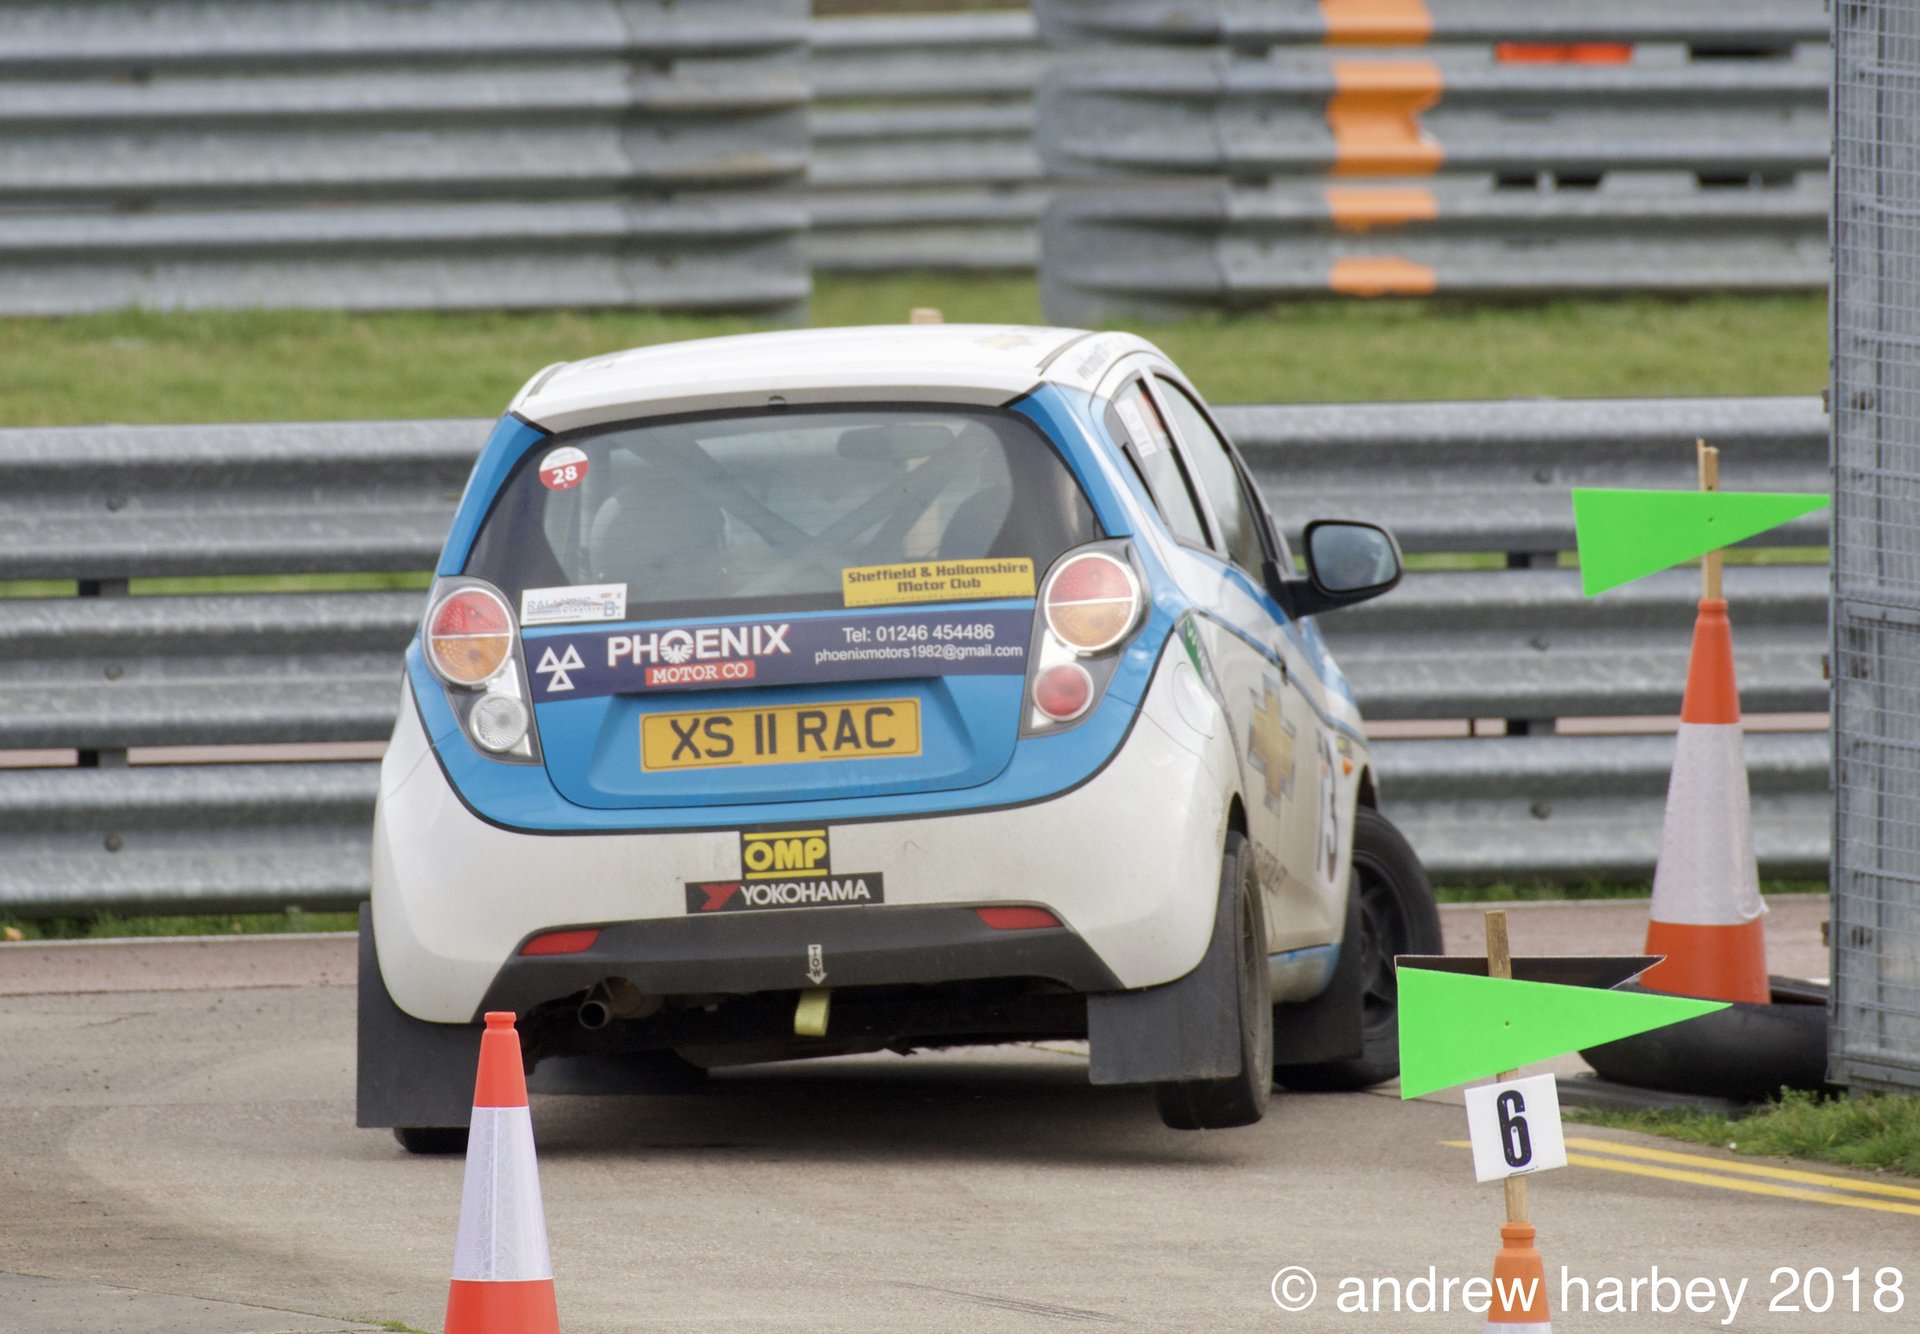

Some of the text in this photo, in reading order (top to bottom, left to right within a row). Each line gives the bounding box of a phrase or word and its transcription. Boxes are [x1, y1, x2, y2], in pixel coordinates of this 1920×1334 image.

[551, 465, 578, 485] 28
[847, 563, 1028, 584] Sheffield & Hallamshire
[897, 577, 981, 593] Motor Club
[842, 624, 995, 643] Tel: 01246 454486
[607, 624, 792, 668] PHOENIX
[815, 644, 1024, 665] phoenixmotors1982@gmail.com
[652, 663, 748, 684] MOTOR CO
[670, 716, 735, 761] XS
[796, 707, 896, 753] RAC
[744, 837, 828, 872] OMP
[740, 878, 871, 906] YOKOHAMA
[1496, 1089, 1533, 1168] 6
